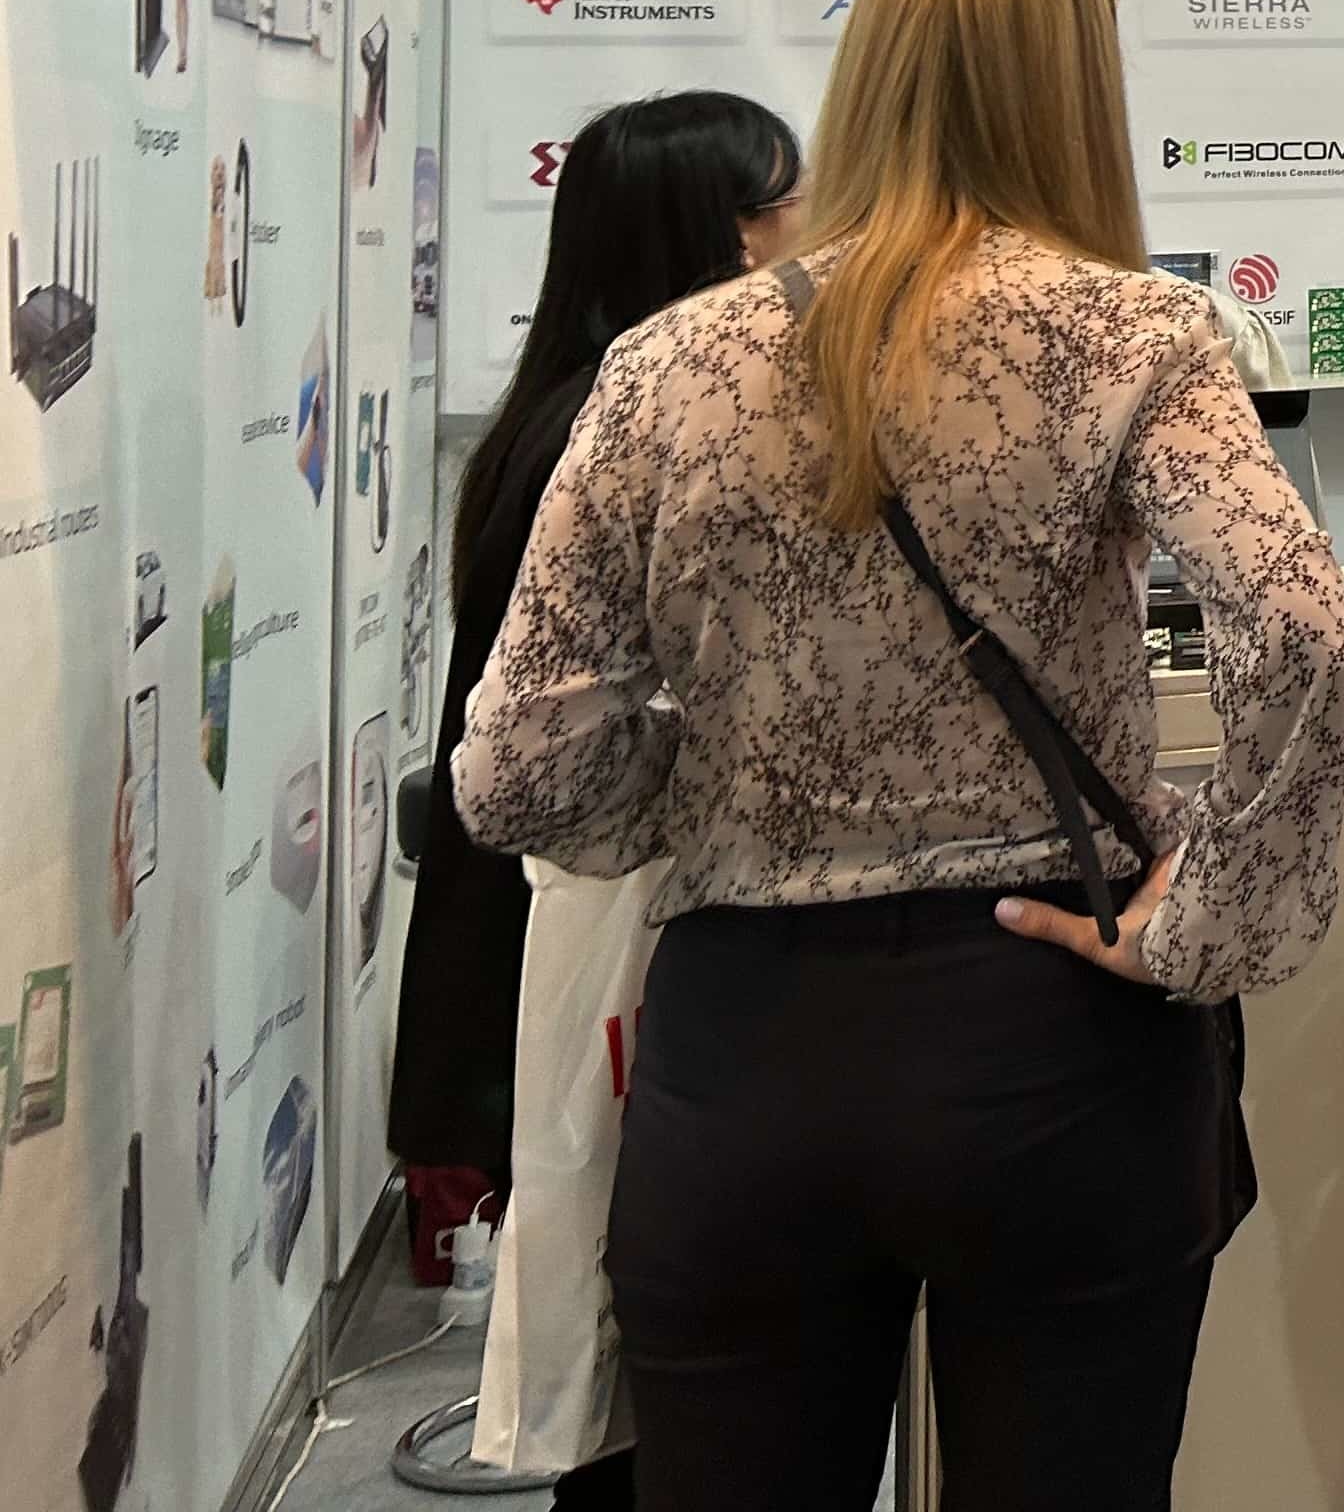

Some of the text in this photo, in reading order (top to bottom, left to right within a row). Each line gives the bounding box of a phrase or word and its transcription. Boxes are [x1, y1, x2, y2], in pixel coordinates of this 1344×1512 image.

[1194, 17, 1309, 30] WIRELESS
[1204, 170, 1241, 179] Perfect
[1243, 169, 1287, 179] Wireless
